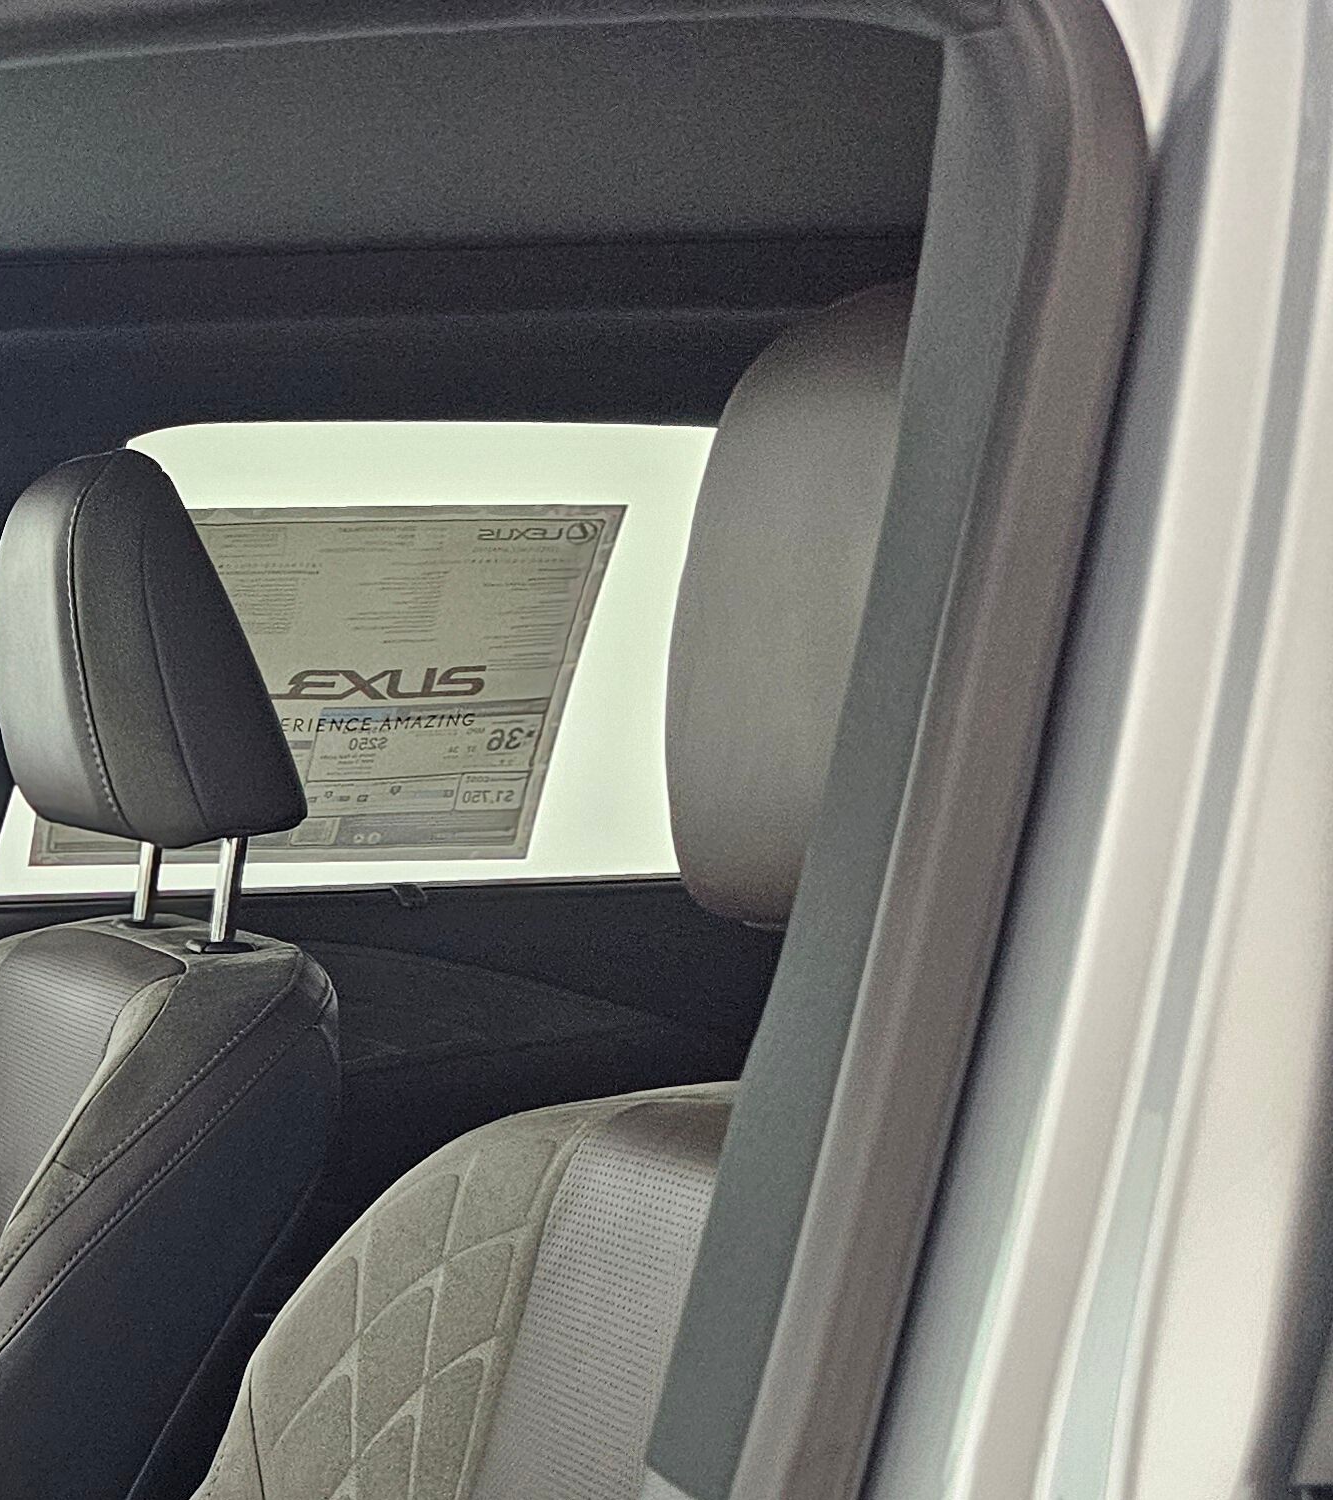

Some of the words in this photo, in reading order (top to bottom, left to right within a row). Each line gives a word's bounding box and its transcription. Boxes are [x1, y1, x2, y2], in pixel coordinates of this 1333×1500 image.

[269, 665, 487, 700] EXUS
[281, 717, 373, 733] ERIENCE
[376, 713, 476, 732] AMAZING
